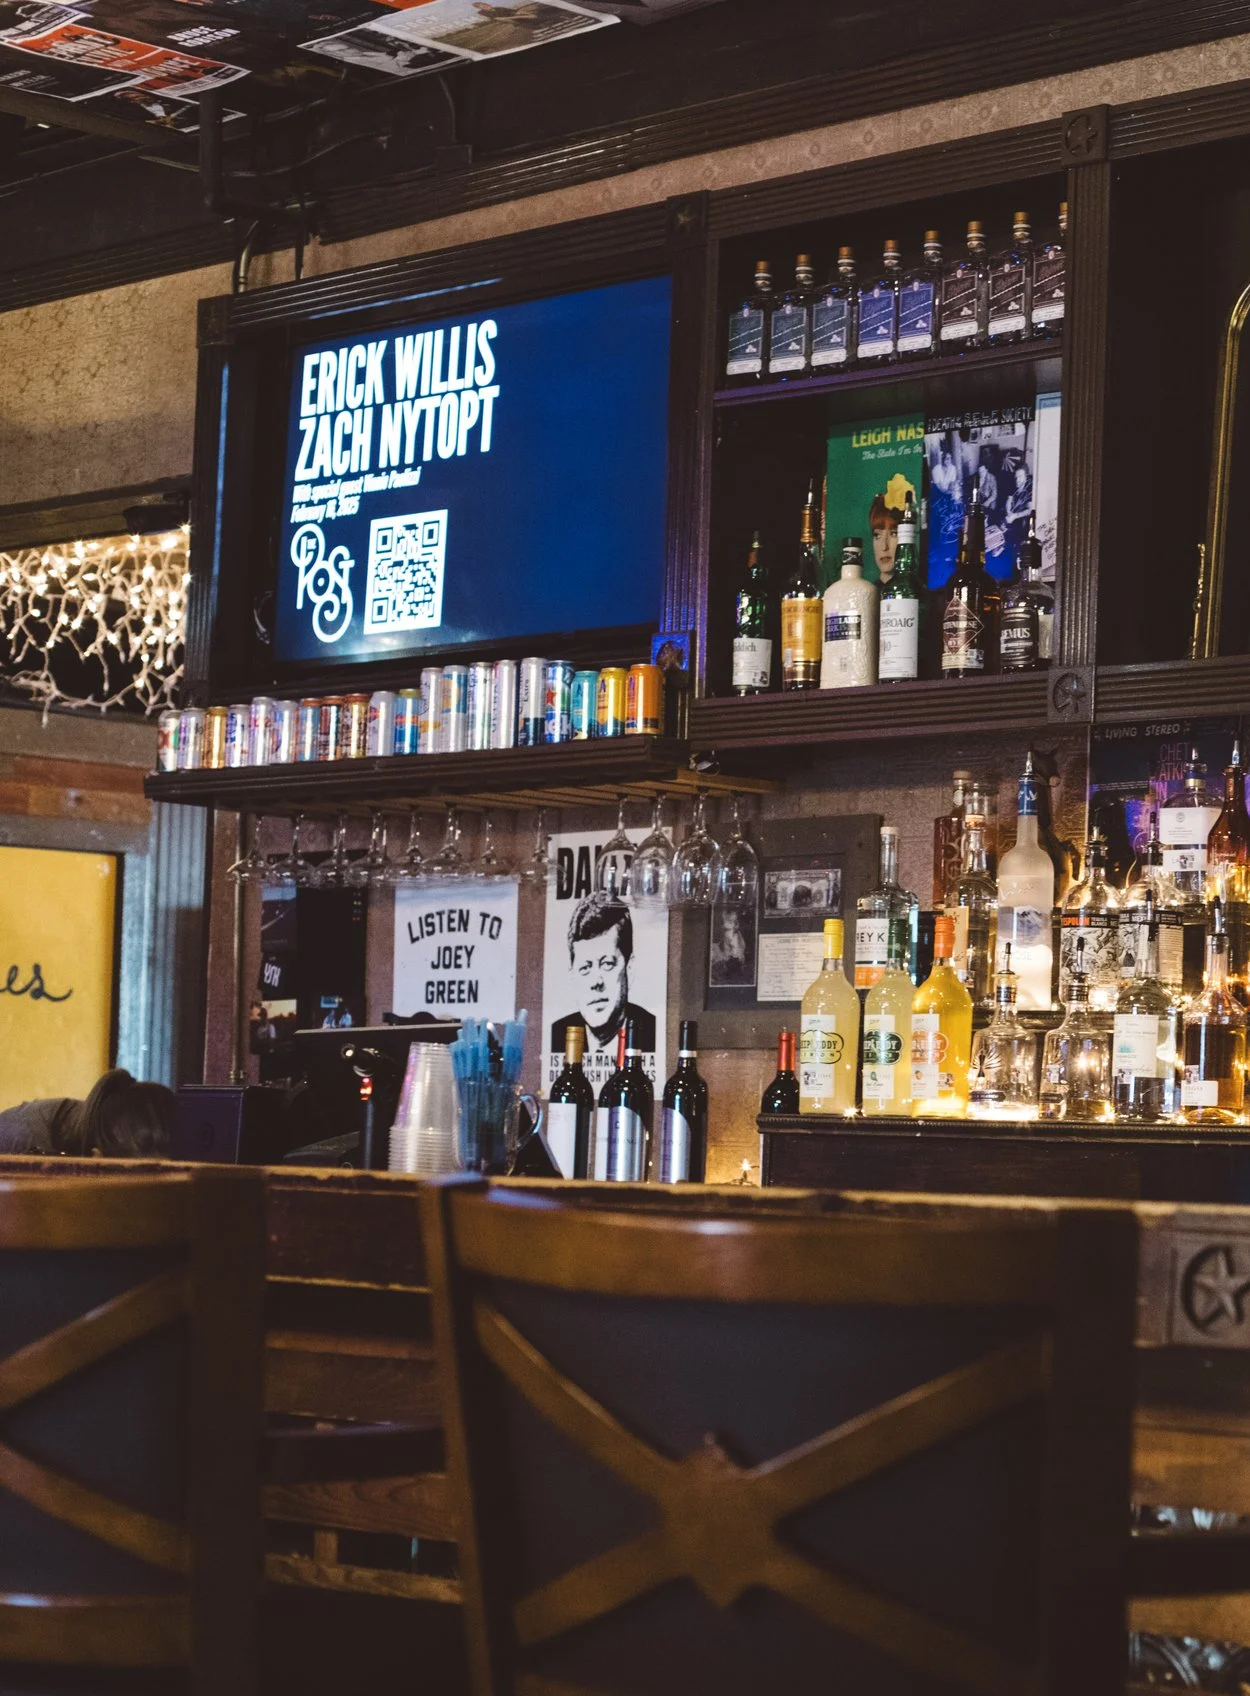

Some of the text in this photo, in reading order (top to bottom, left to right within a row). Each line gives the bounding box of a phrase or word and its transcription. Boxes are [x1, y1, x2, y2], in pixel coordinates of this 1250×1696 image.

[301, 319, 498, 417] ERICK WILLIS
[294, 385, 500, 481] ZACH NYTOPT
[852, 421, 924, 448] LEIGH NAS
[880, 617, 915, 628] HROAIG
[1105, 723, 1181, 739] LIVING STEREO
[1158, 762, 1185, 782] ATKI
[406, 908, 503, 943] LISTEN TO
[857, 932, 885, 943] EYK
[430, 944, 475, 971] JOEY
[424, 979, 479, 1004] GREEN
[550, 1055, 560, 1067] IS
